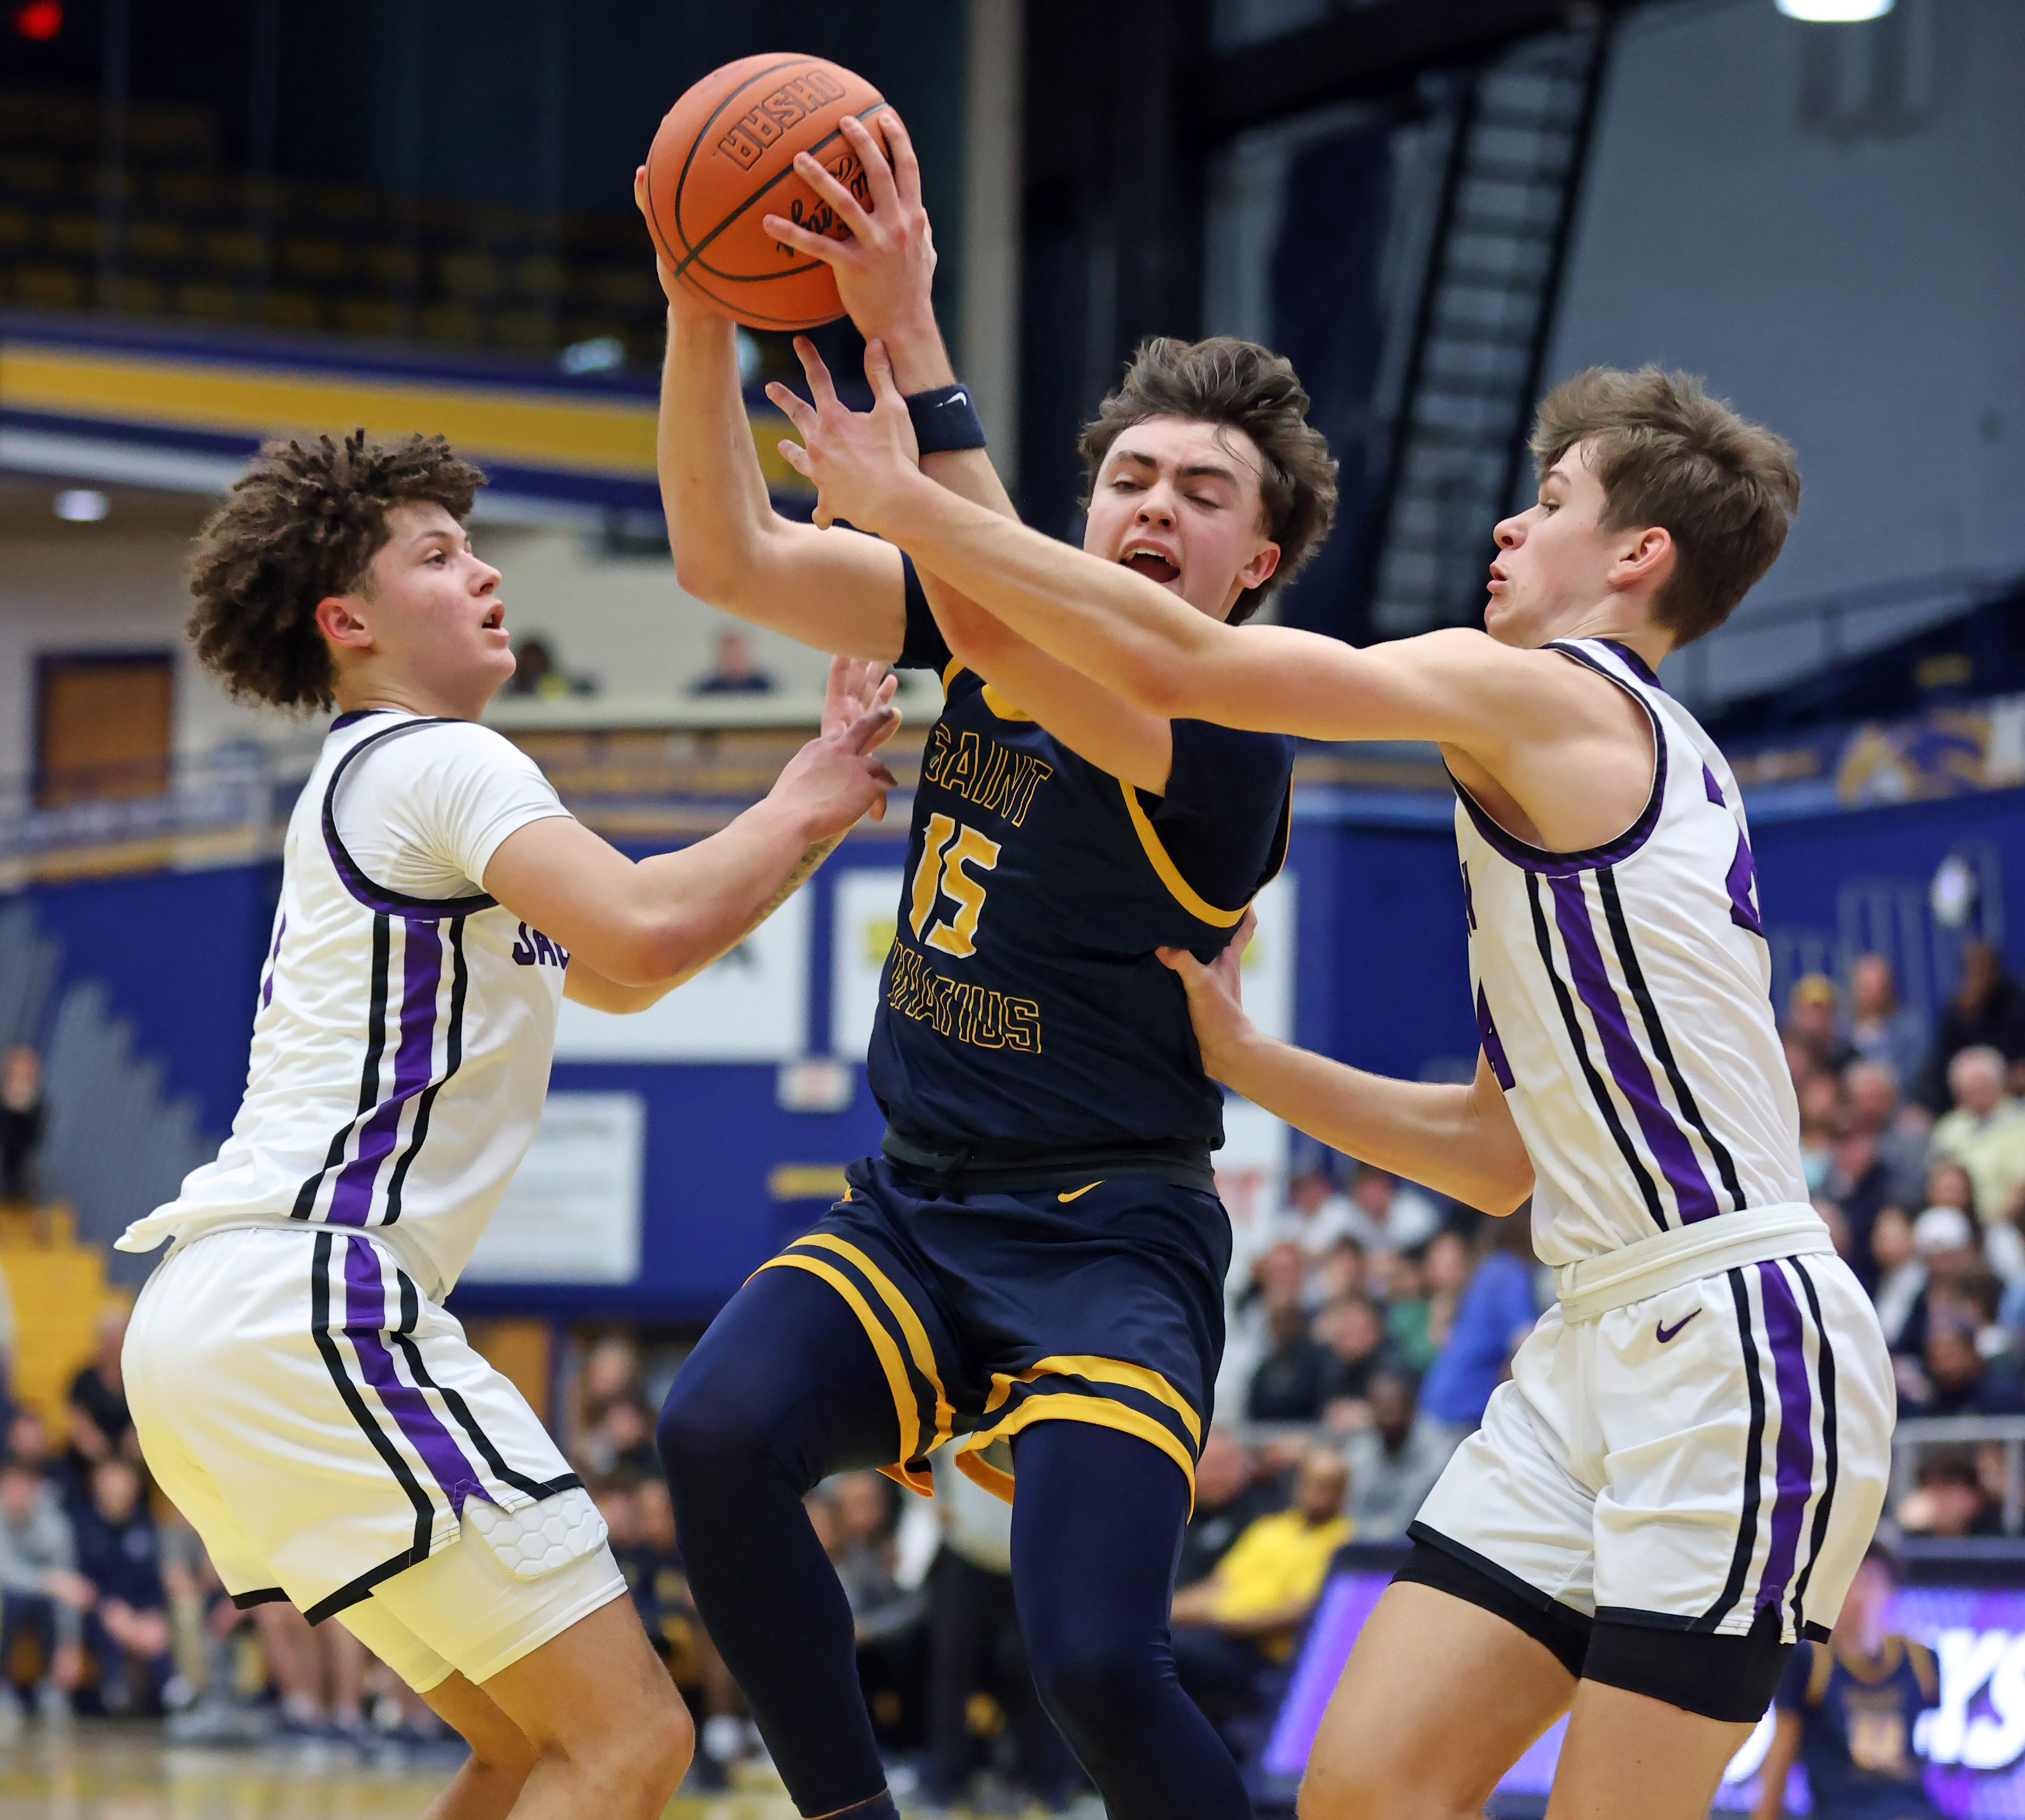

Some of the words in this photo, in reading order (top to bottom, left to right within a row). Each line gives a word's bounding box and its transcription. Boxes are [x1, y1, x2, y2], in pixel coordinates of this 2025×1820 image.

[717, 69, 846, 171] OHSAA
[925, 722, 1054, 828] SAINT
[909, 812, 1002, 959] 15
